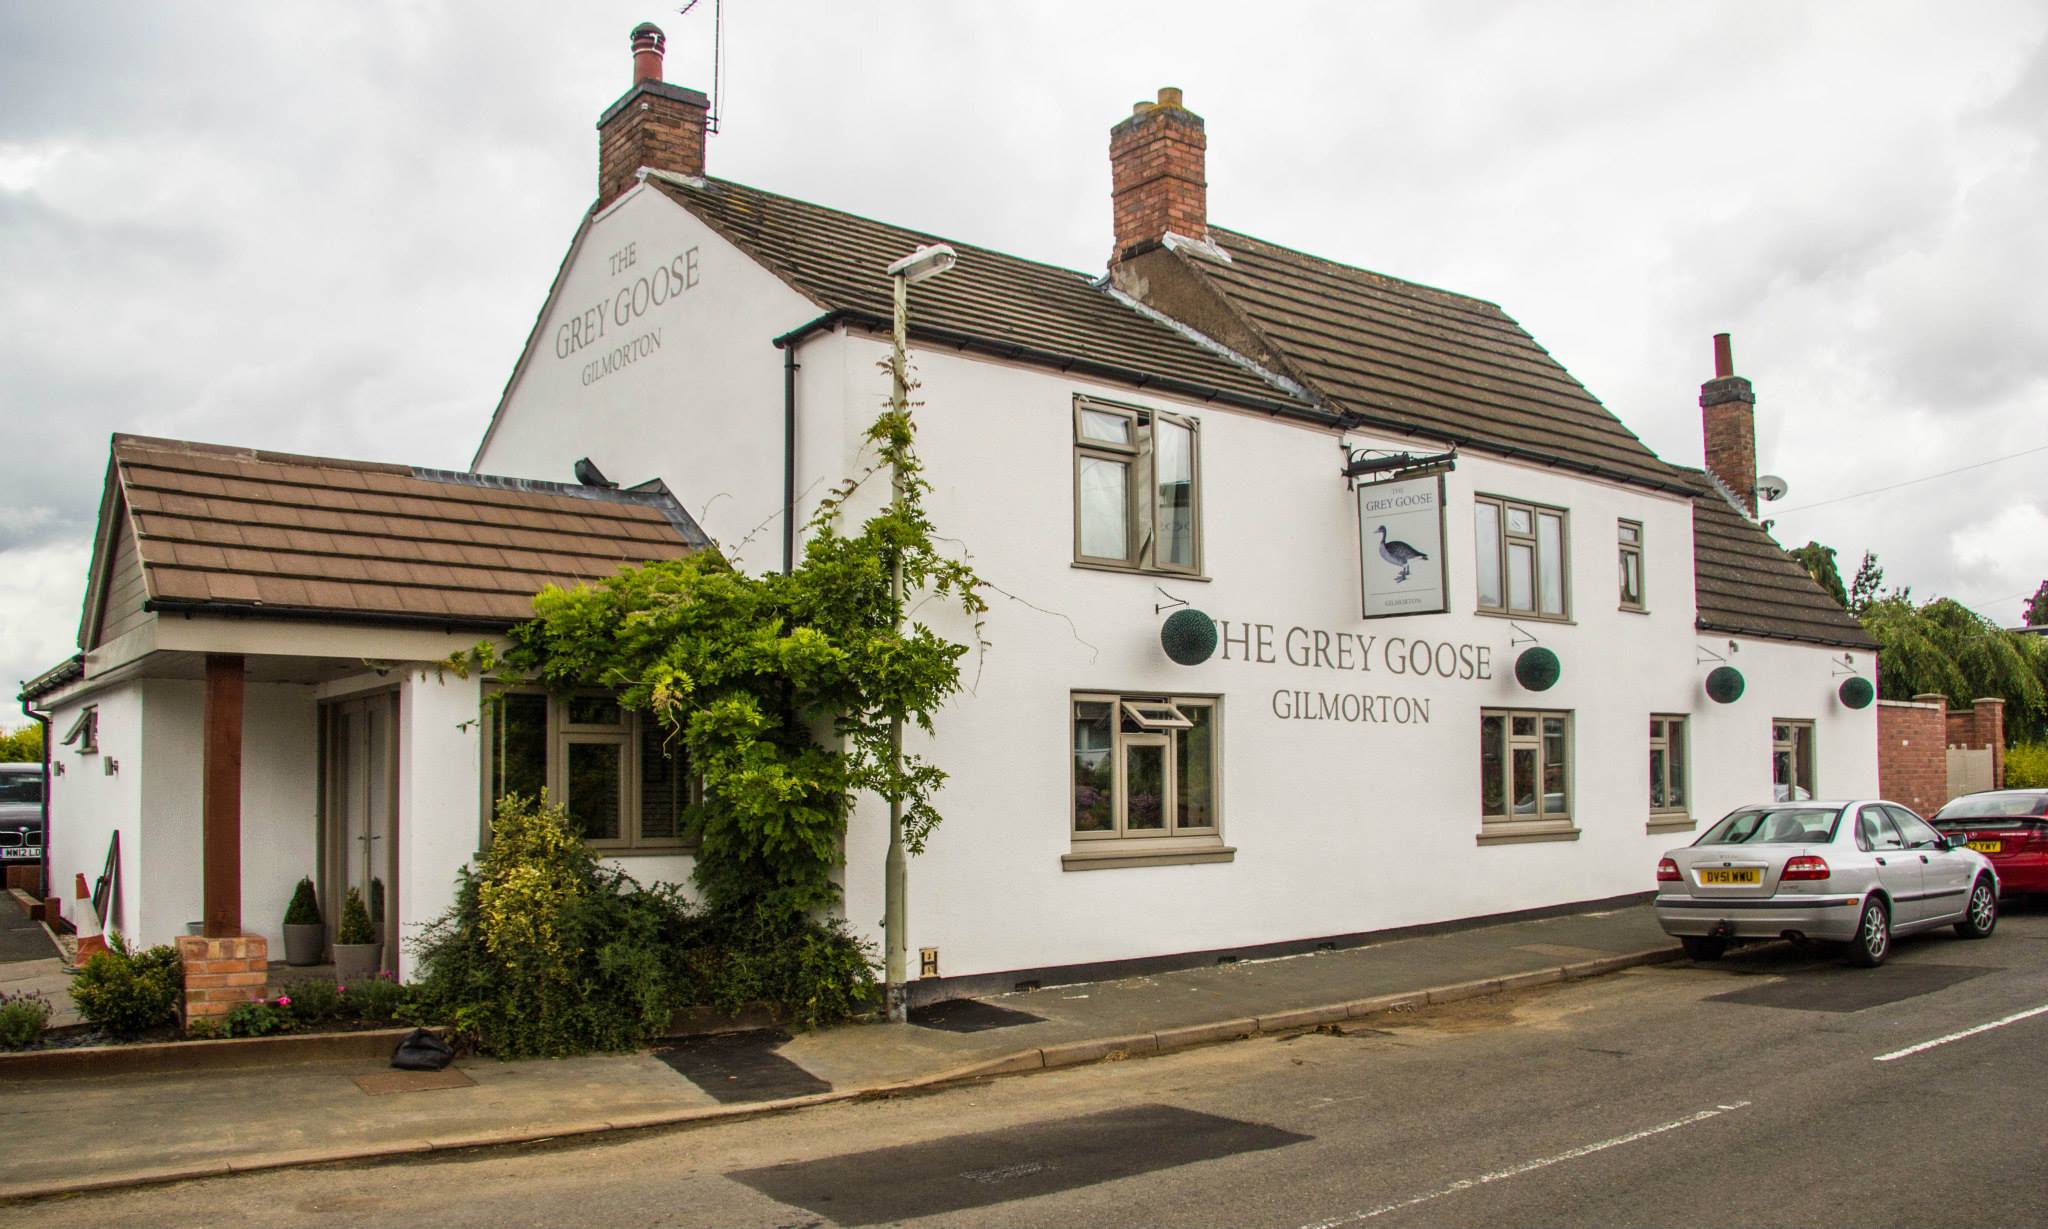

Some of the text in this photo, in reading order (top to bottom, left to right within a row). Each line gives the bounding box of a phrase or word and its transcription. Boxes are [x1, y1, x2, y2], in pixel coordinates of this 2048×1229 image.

[609, 242, 637, 276] THE
[556, 246, 700, 360] GREY GOOSE
[582, 328, 662, 386] GILMORTON
[1366, 493, 1432, 511] GREY GOOSE
[1211, 619, 1492, 680] HE GREY GOOSE
[1272, 689, 1431, 724] GILMORTON
